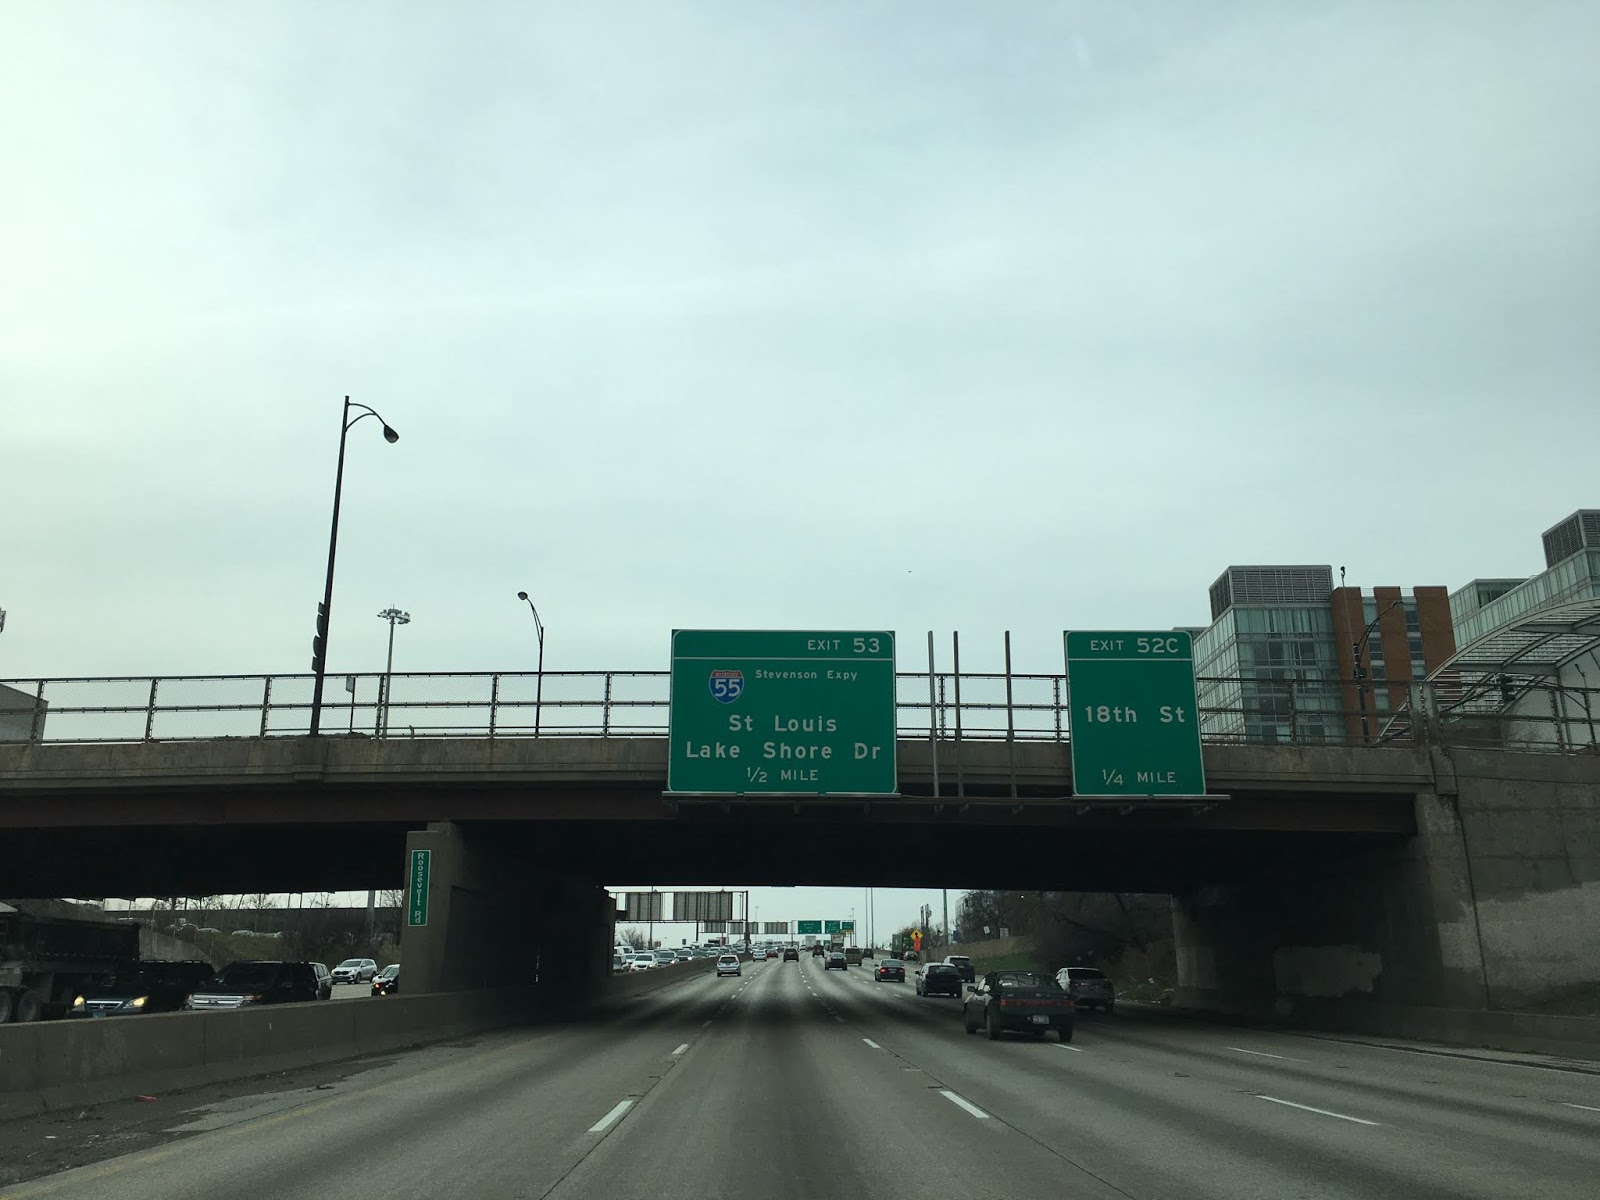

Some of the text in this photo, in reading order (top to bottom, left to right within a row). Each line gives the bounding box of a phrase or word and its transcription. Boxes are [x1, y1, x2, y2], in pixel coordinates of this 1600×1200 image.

[807, 637, 880, 653] EXIT 53
[1090, 637, 1179, 654] EXIT 52C
[755, 669, 858, 681] Stevenson Expy
[714, 678, 741, 697] 55
[1085, 705, 1185, 723] 18th St
[728, 714, 837, 732] St Louis
[686, 741, 881, 760] Lake Shore Dr
[780, 769, 819, 781] MILE
[1137, 771, 1176, 783] MILE
[414, 852, 425, 924] Roosevelt Rd
